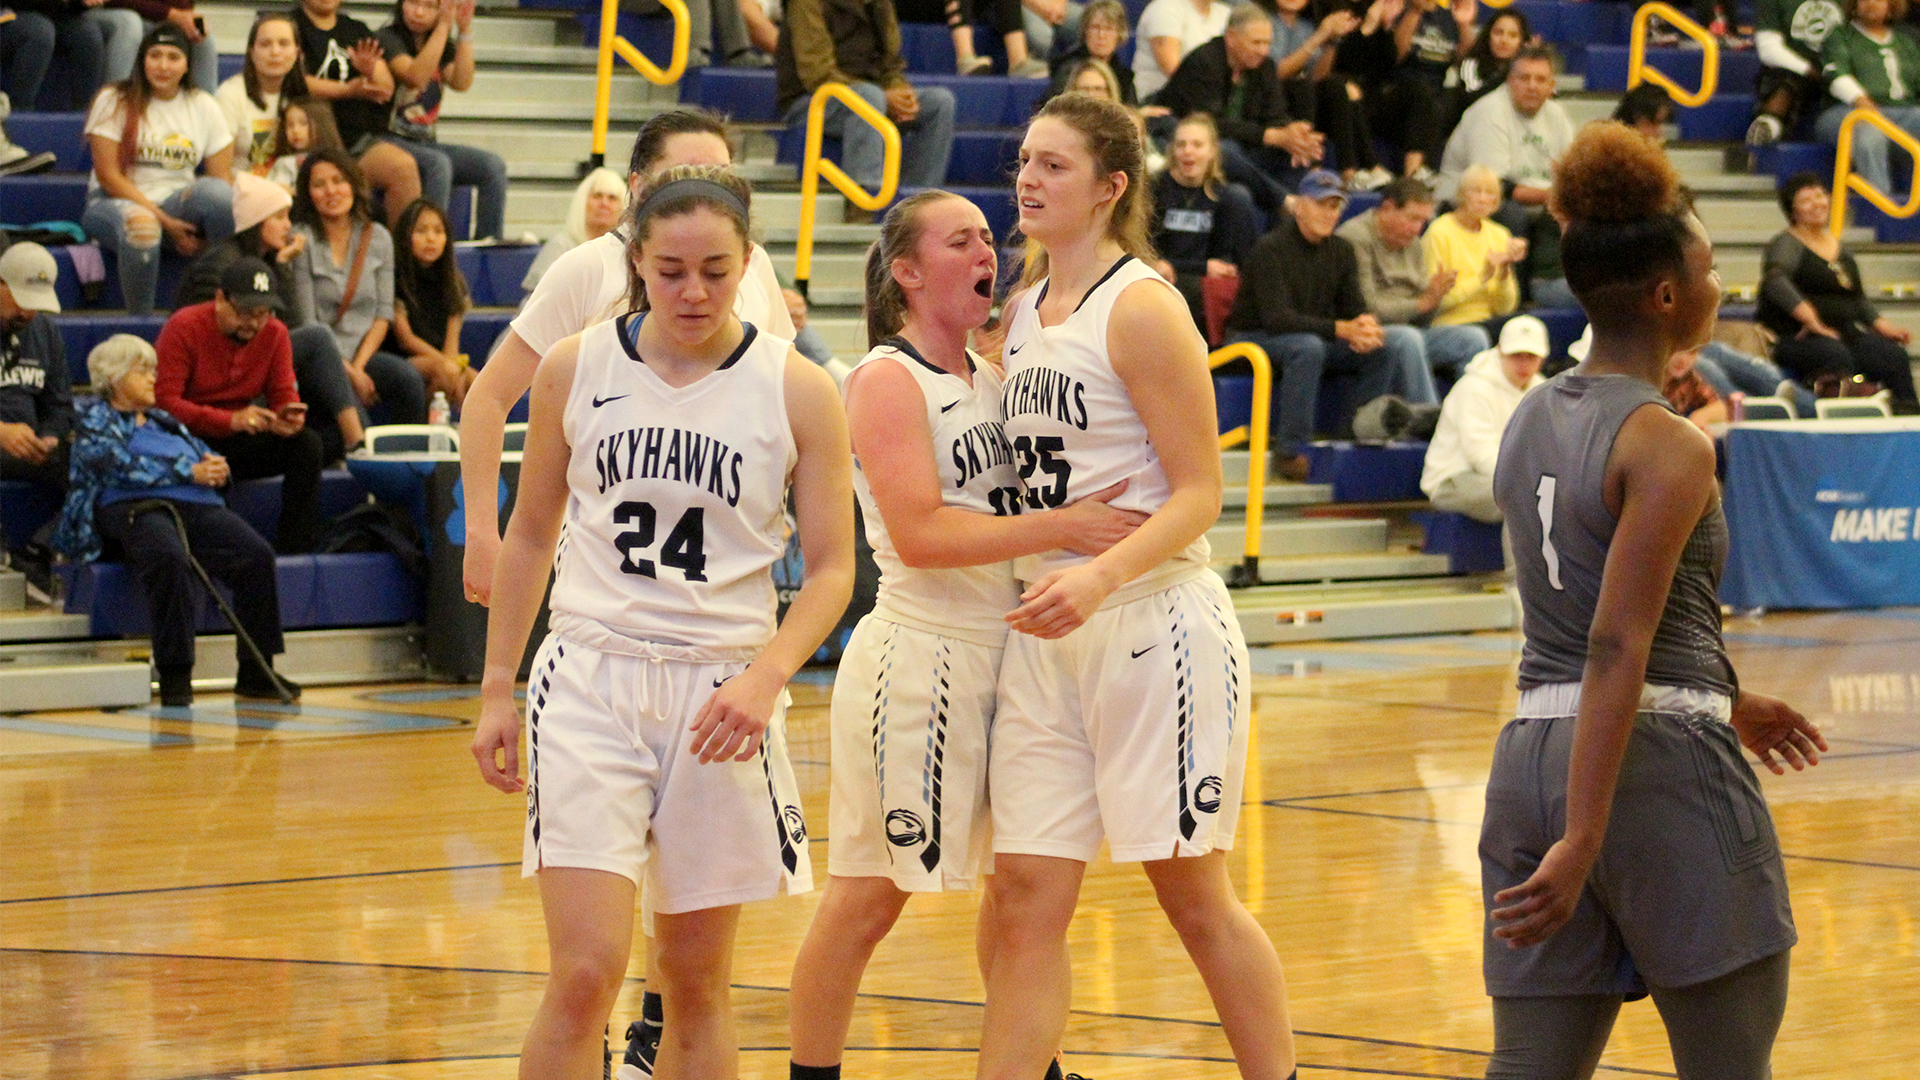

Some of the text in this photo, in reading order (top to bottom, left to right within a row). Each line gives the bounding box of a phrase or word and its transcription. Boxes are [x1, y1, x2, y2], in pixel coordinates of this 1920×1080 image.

[596, 427, 743, 508] SKYHAWKS
[1013, 435, 1072, 509] 25
[613, 500, 708, 583] 24
[1536, 473, 1564, 590] 1
[1830, 507, 1911, 543] MAKE
